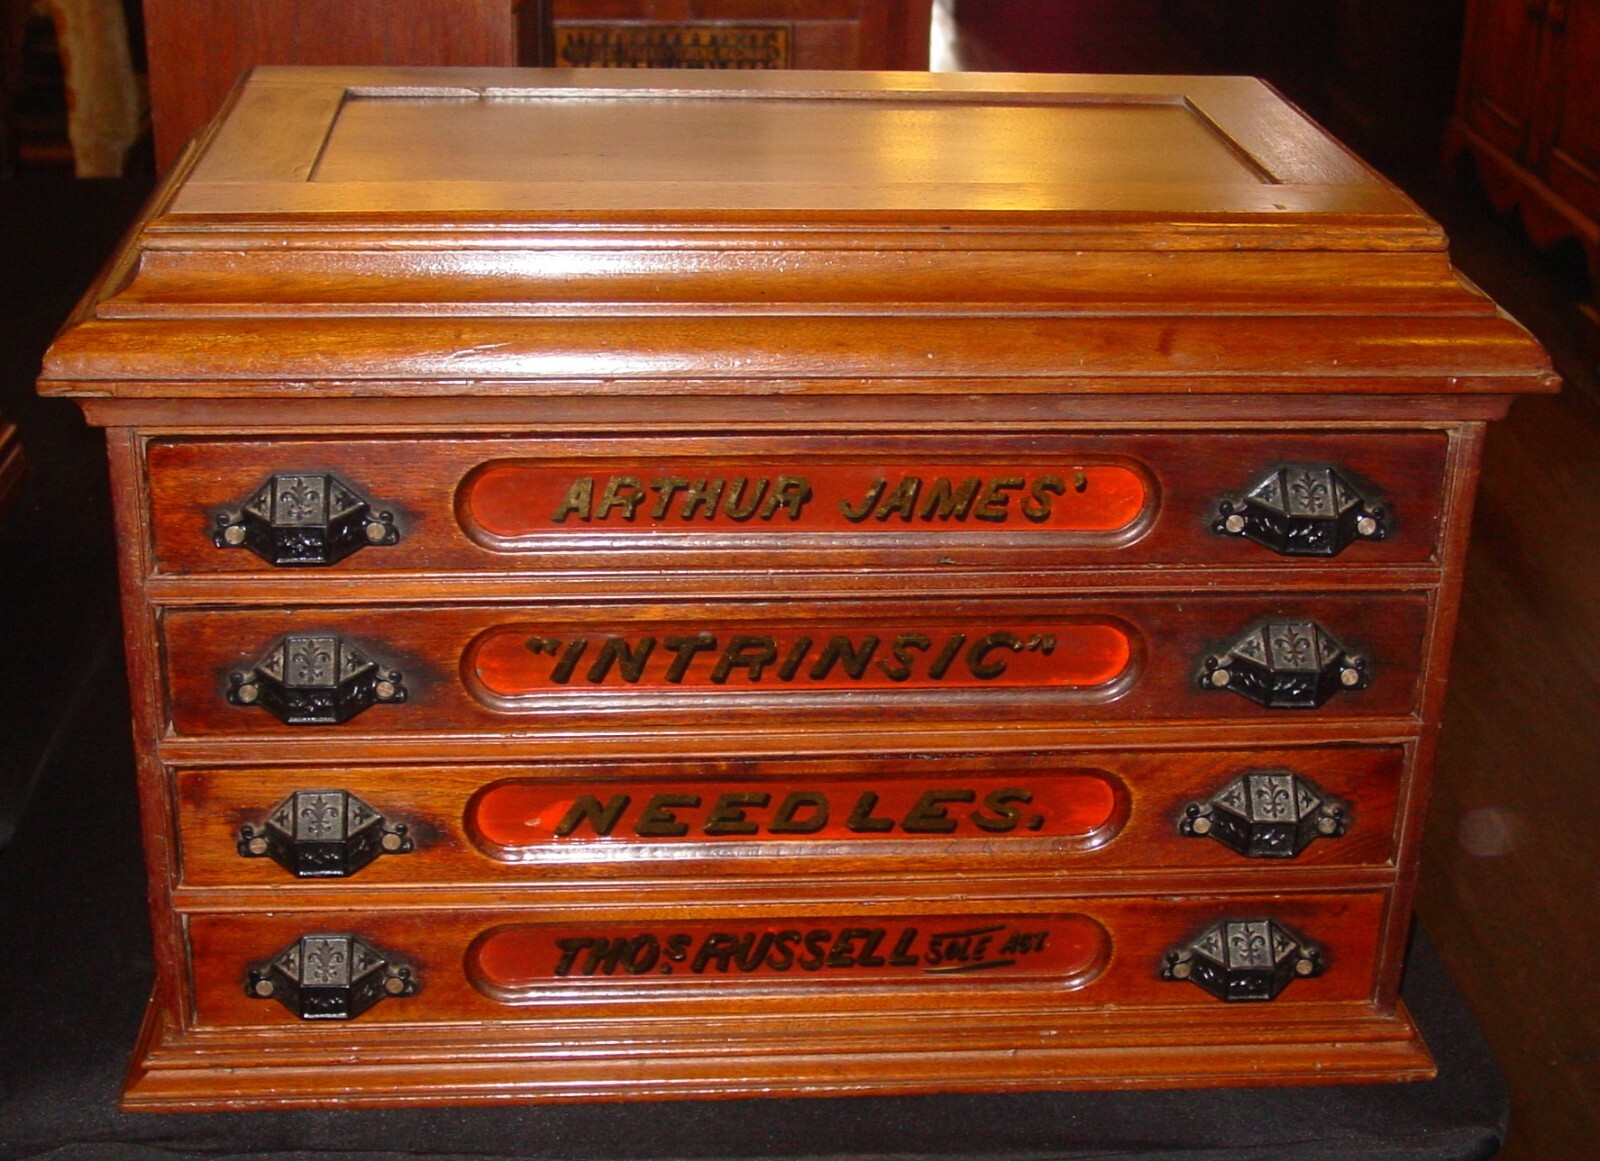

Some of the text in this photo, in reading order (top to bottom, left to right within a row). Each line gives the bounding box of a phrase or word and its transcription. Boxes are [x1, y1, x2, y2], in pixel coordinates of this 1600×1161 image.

[552, 473, 1087, 522] ARTHUR JAMES'
[554, 791, 1044, 837] NEEDLES.
[692, 928, 919, 972] RUSSELL
